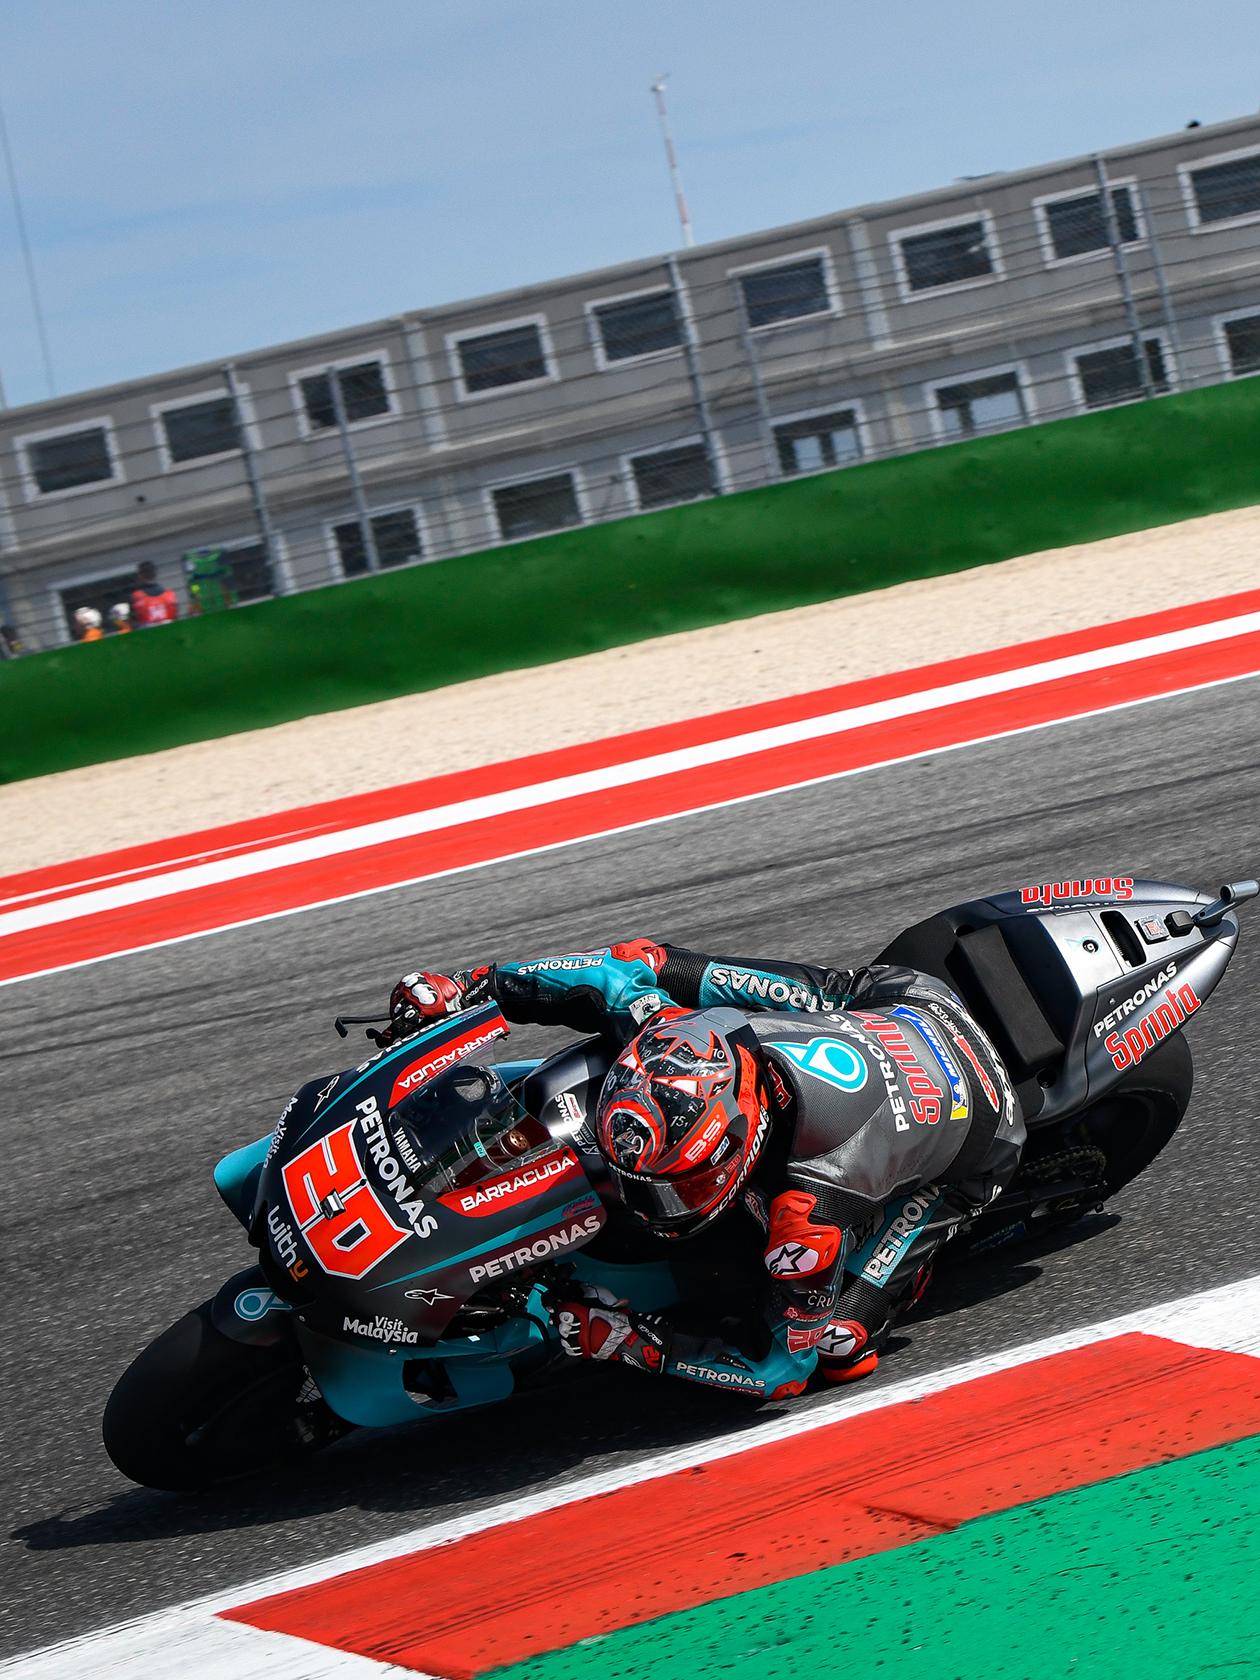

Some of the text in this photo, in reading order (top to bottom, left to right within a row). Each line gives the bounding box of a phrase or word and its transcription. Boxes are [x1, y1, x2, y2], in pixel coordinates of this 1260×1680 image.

[1018, 877, 1135, 905] Sprinta
[517, 956, 603, 977] PETRONAS
[1093, 961, 1179, 1040] PETRONAS
[1104, 981, 1203, 1072] Sprinta
[397, 1027, 505, 1089] BARRACUDA
[827, 1013, 910, 1133] PETRONAS
[847, 1010, 943, 1126] Sprinta
[391, 1127, 423, 1173] YAMAHA
[553, 1093, 586, 1149] PETONAS
[684, 1119, 723, 1162] BS
[354, 1094, 439, 1241] PETRONAS
[460, 1155, 577, 1214] BARRACUDA
[608, 1162, 653, 1184] PETRONAS
[709, 1116, 769, 1221] SCORPION
[281, 1116, 414, 1281] 20
[266, 1204, 309, 1284] withu
[469, 1215, 603, 1284] PETRONAS
[343, 1316, 419, 1345] Malaysia
[374, 1315, 404, 1332] Visit
[675, 1361, 766, 1389] PETRONAS
